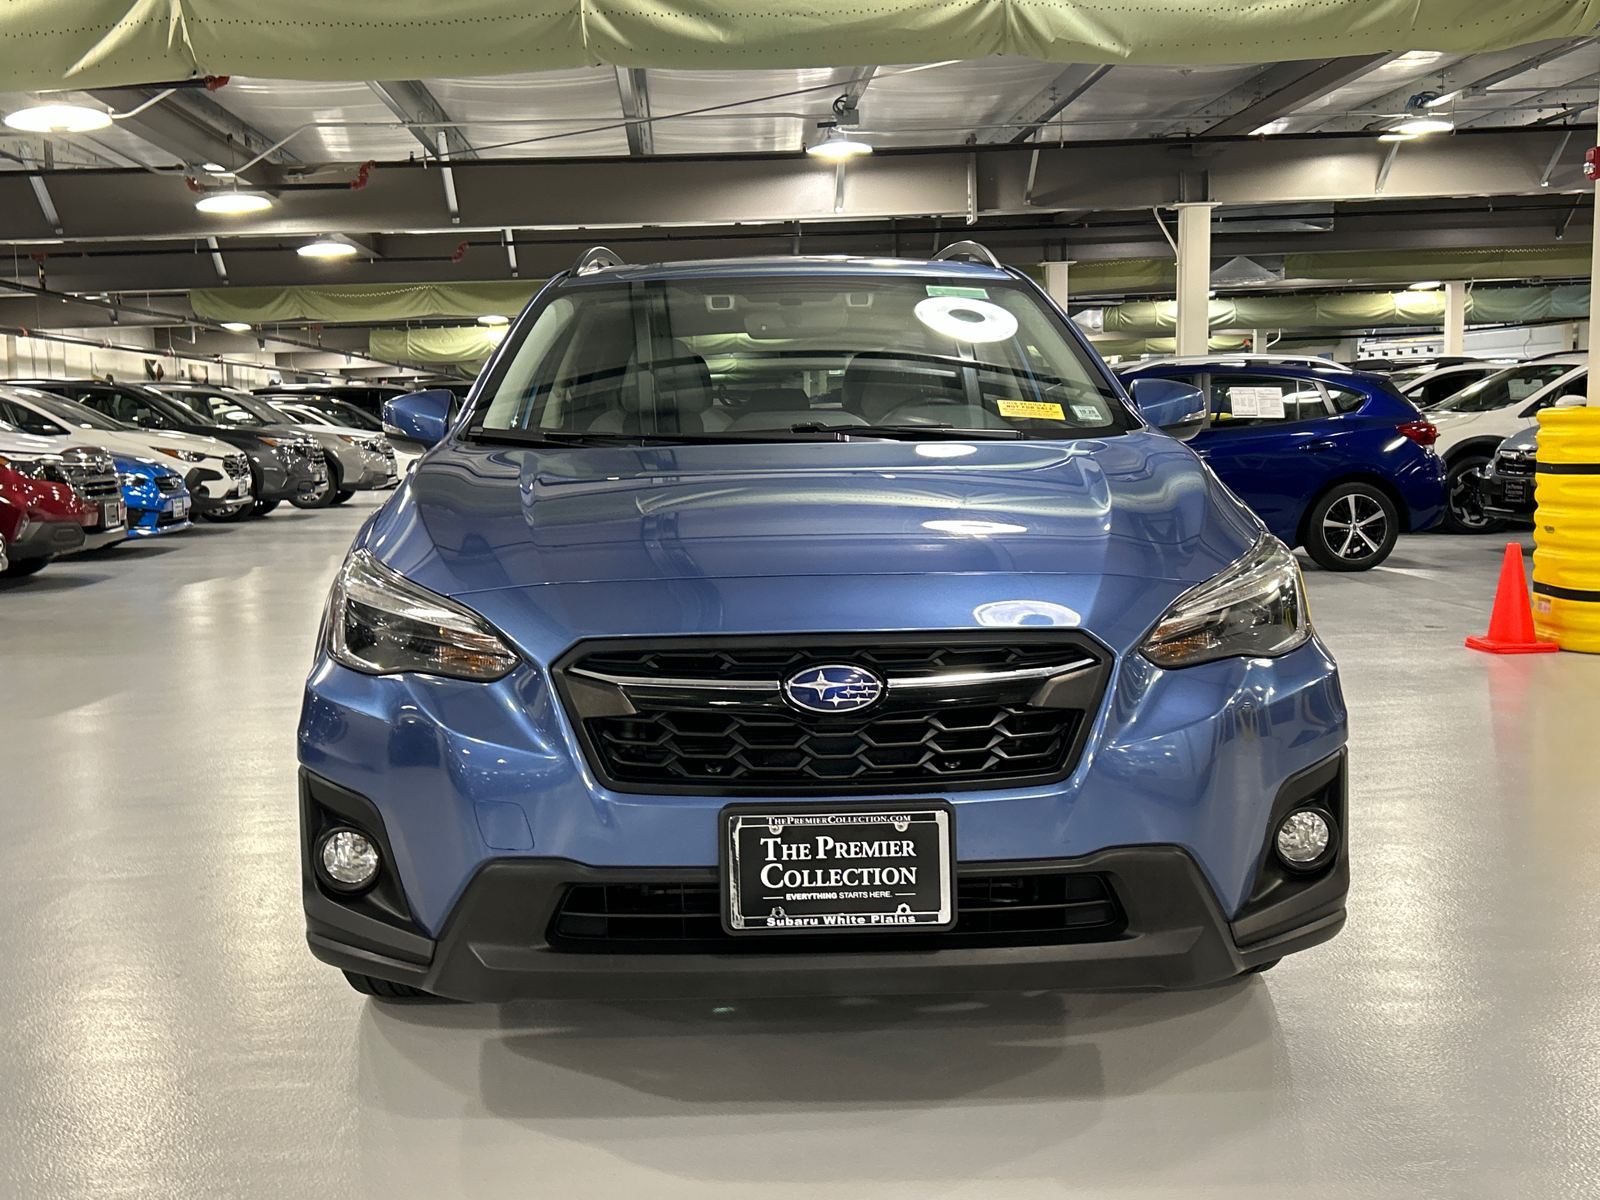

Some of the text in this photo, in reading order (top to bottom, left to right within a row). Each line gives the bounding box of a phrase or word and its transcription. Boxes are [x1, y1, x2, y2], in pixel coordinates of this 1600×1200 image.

[760, 836, 917, 861] THE PREMIER
[760, 863, 918, 889] COLLECTION
[786, 890, 893, 901] EVERYTHING STARTS HERE.
[766, 914, 916, 927] Subaru White Plains
